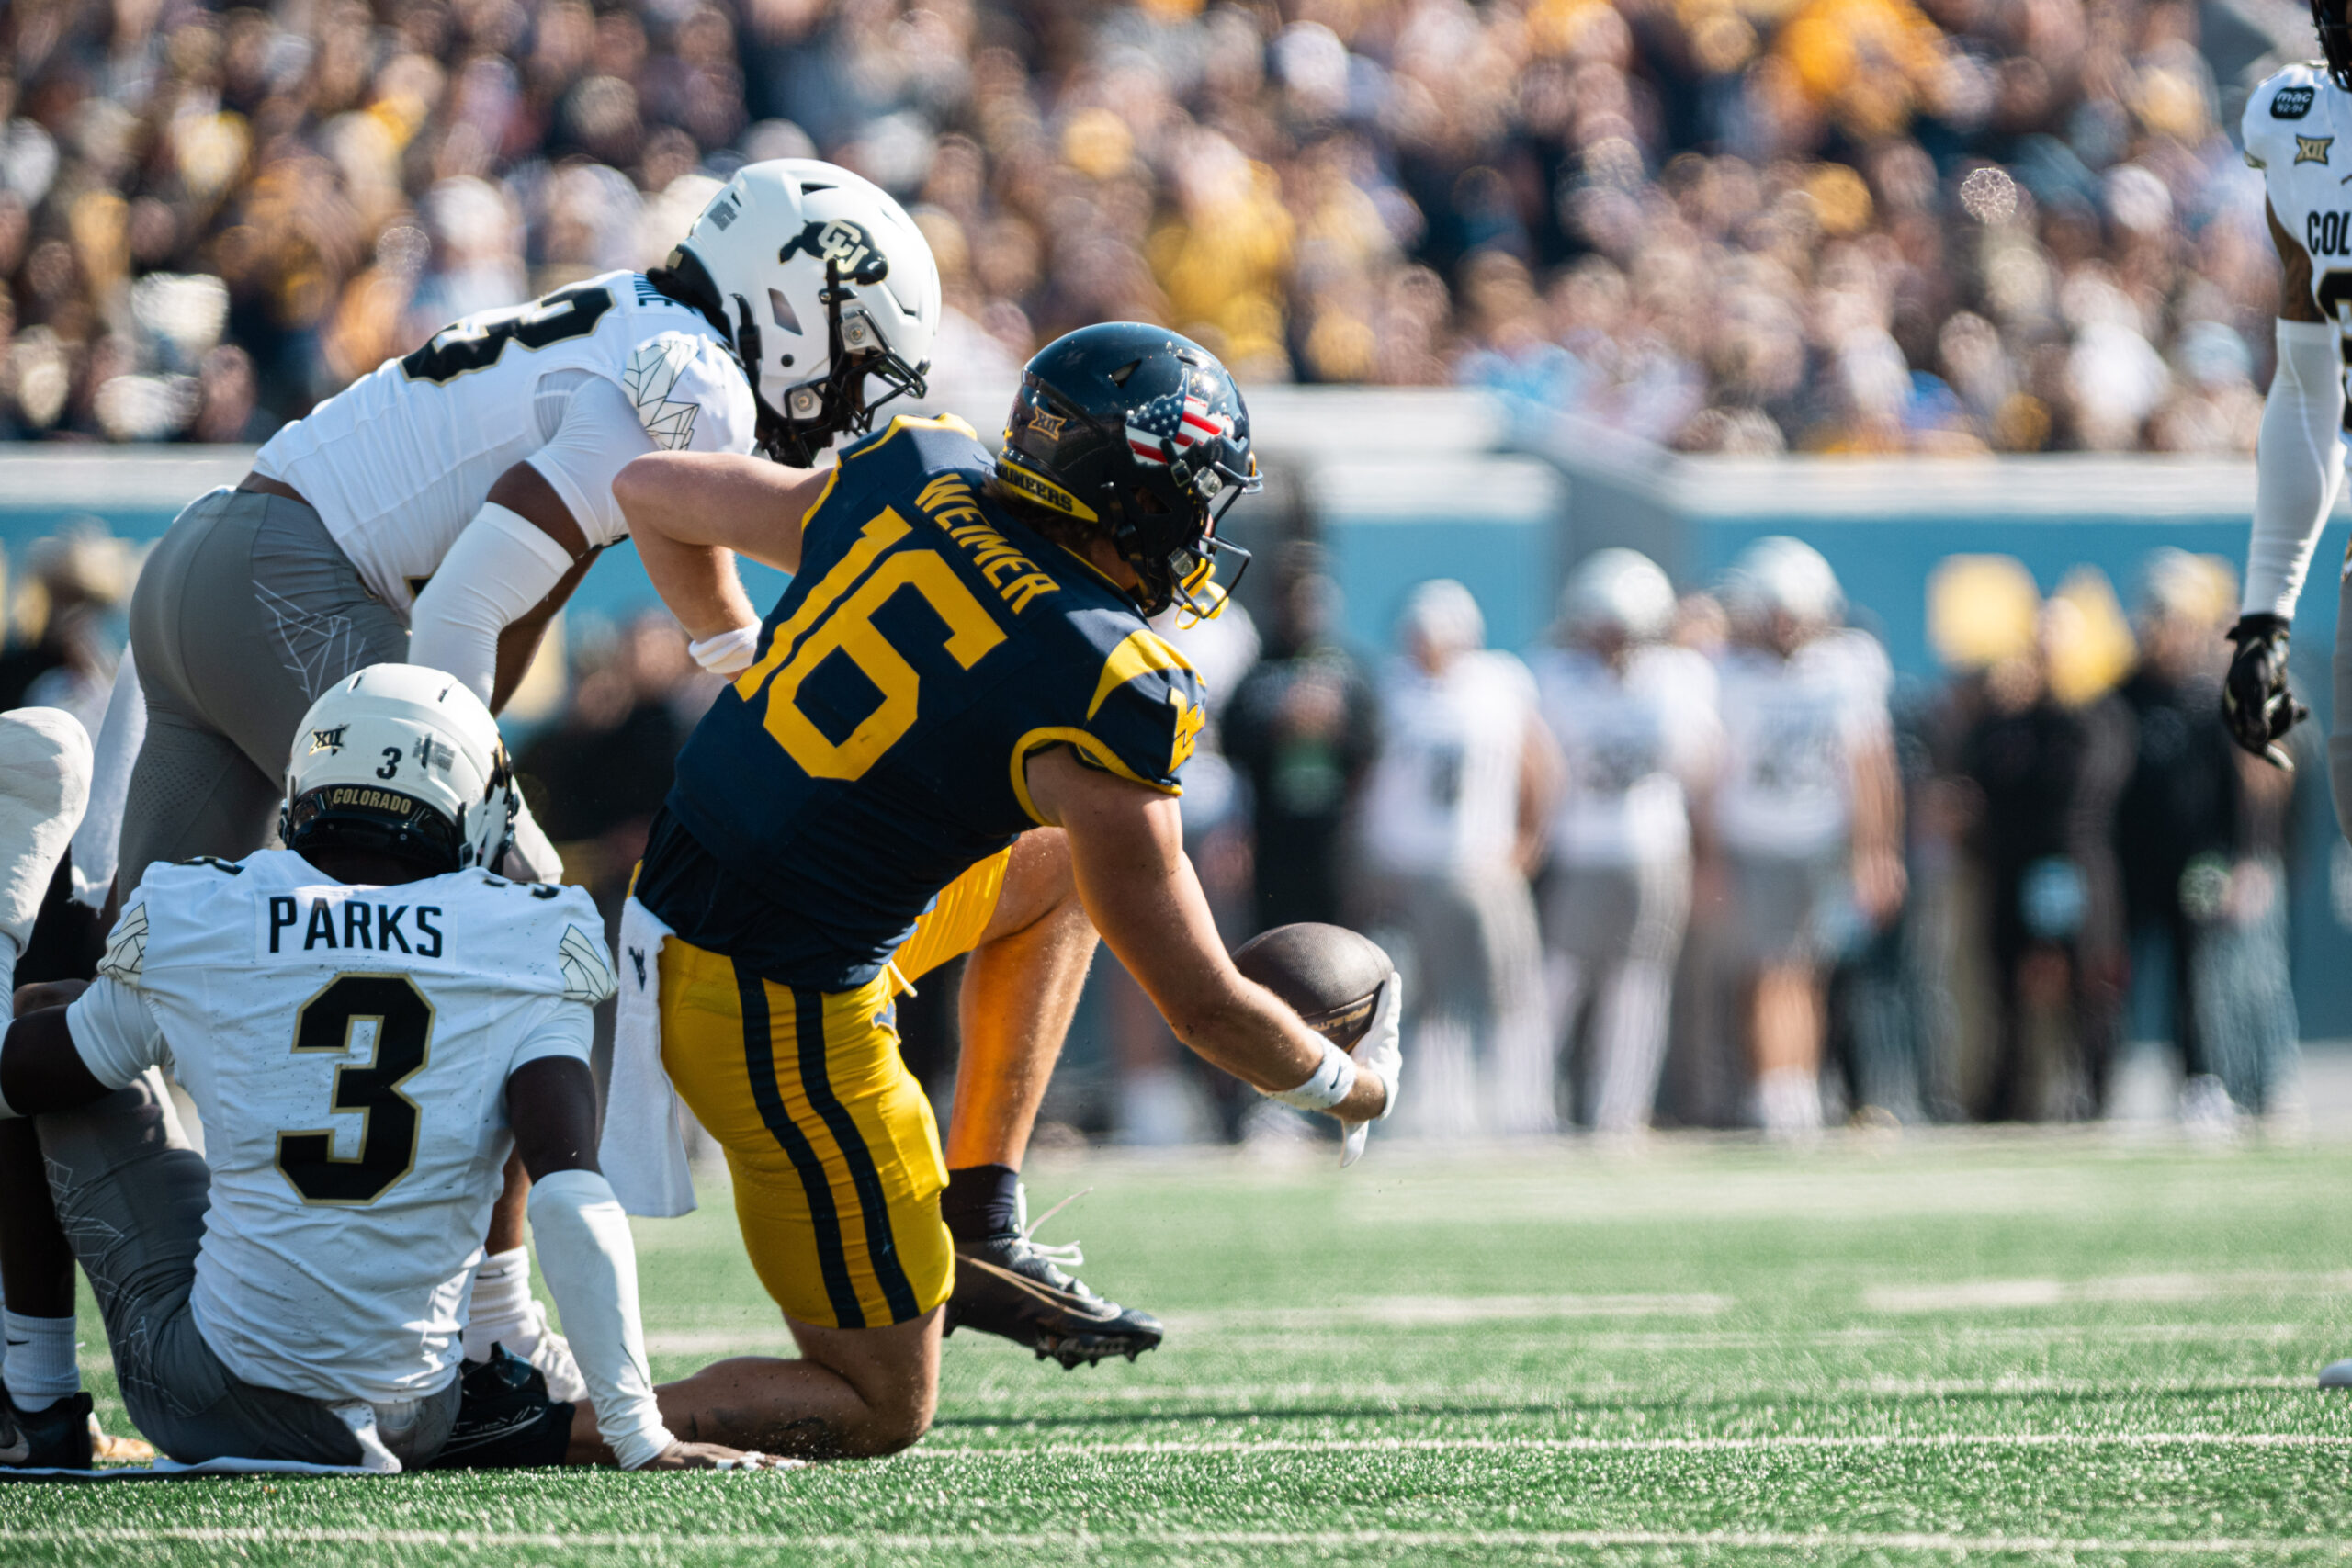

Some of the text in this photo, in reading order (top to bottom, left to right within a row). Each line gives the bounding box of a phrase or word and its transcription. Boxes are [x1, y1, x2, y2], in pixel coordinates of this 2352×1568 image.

[2277, 91, 2312, 103] mac
[914, 473, 1061, 615] WEIMER
[734, 504, 1009, 782] 16
[376, 746, 402, 780] 3
[332, 787, 412, 815] COLORADO
[269, 896, 443, 958] PARKS
[275, 970, 436, 1206] 3
